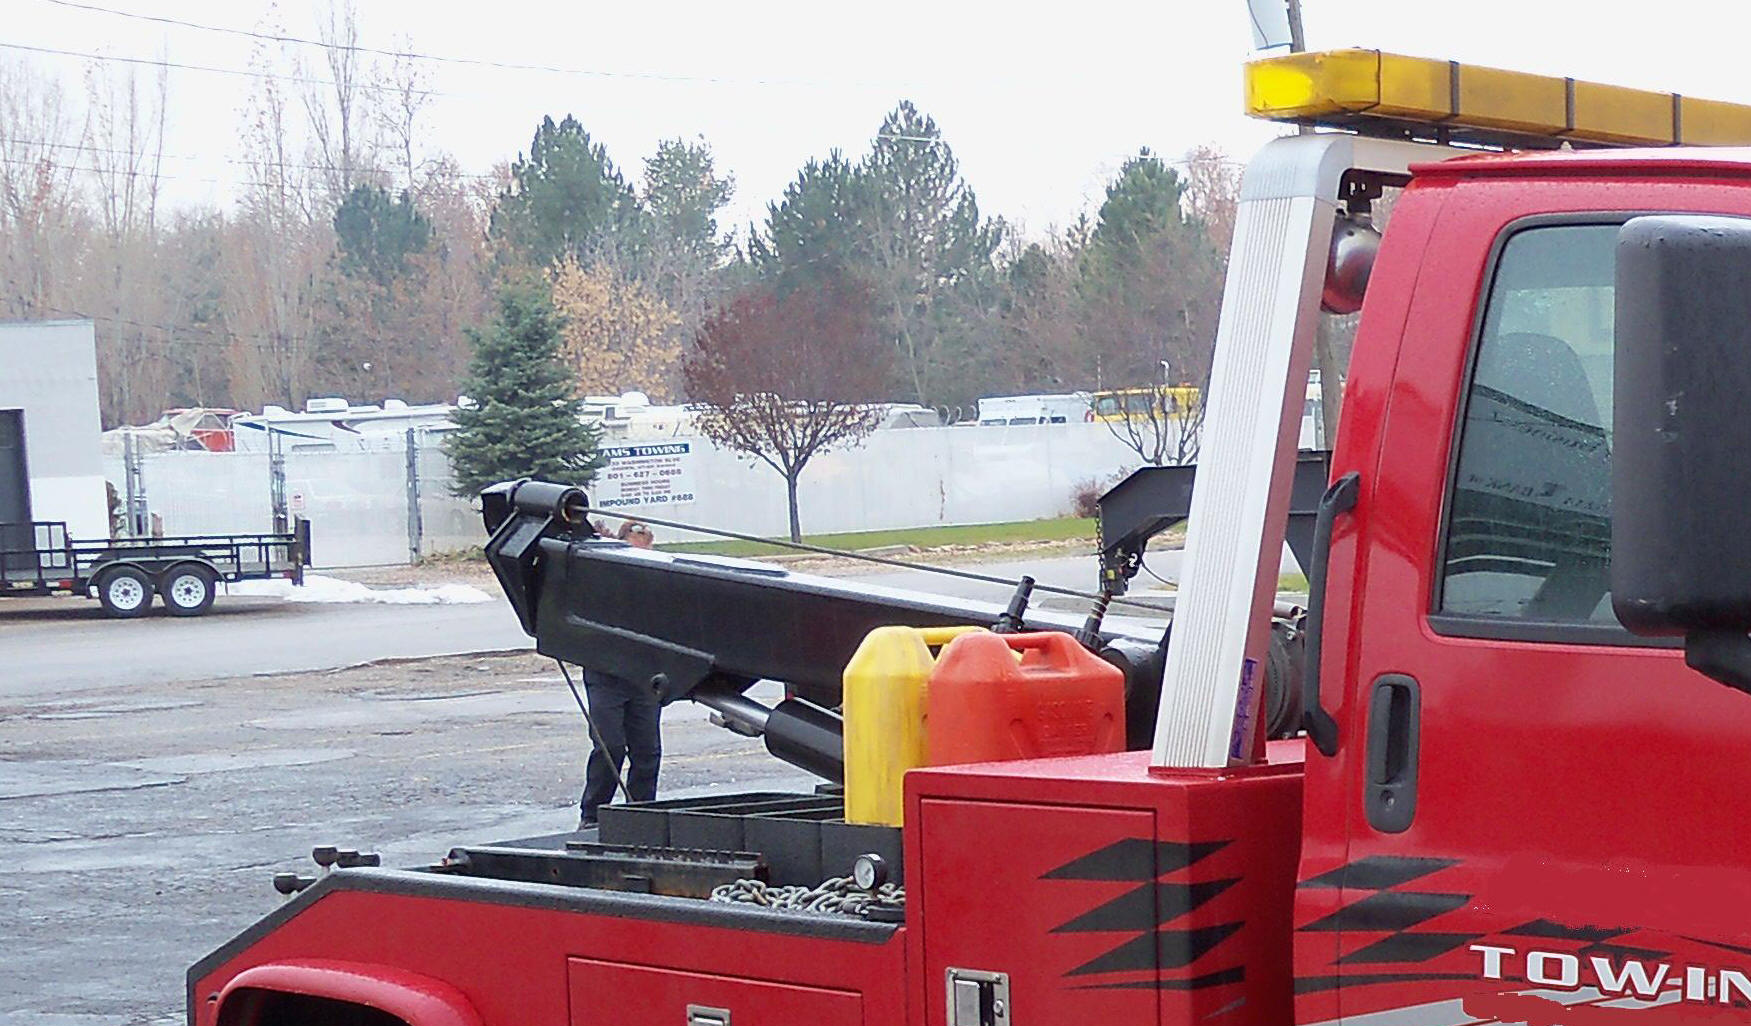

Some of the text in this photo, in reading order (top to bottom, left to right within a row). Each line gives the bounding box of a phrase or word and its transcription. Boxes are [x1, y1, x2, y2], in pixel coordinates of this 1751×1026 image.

[602, 445, 685, 458] AMS TOWING
[599, 497, 641, 508] IMPOUND
[643, 494, 668, 504] YARD
